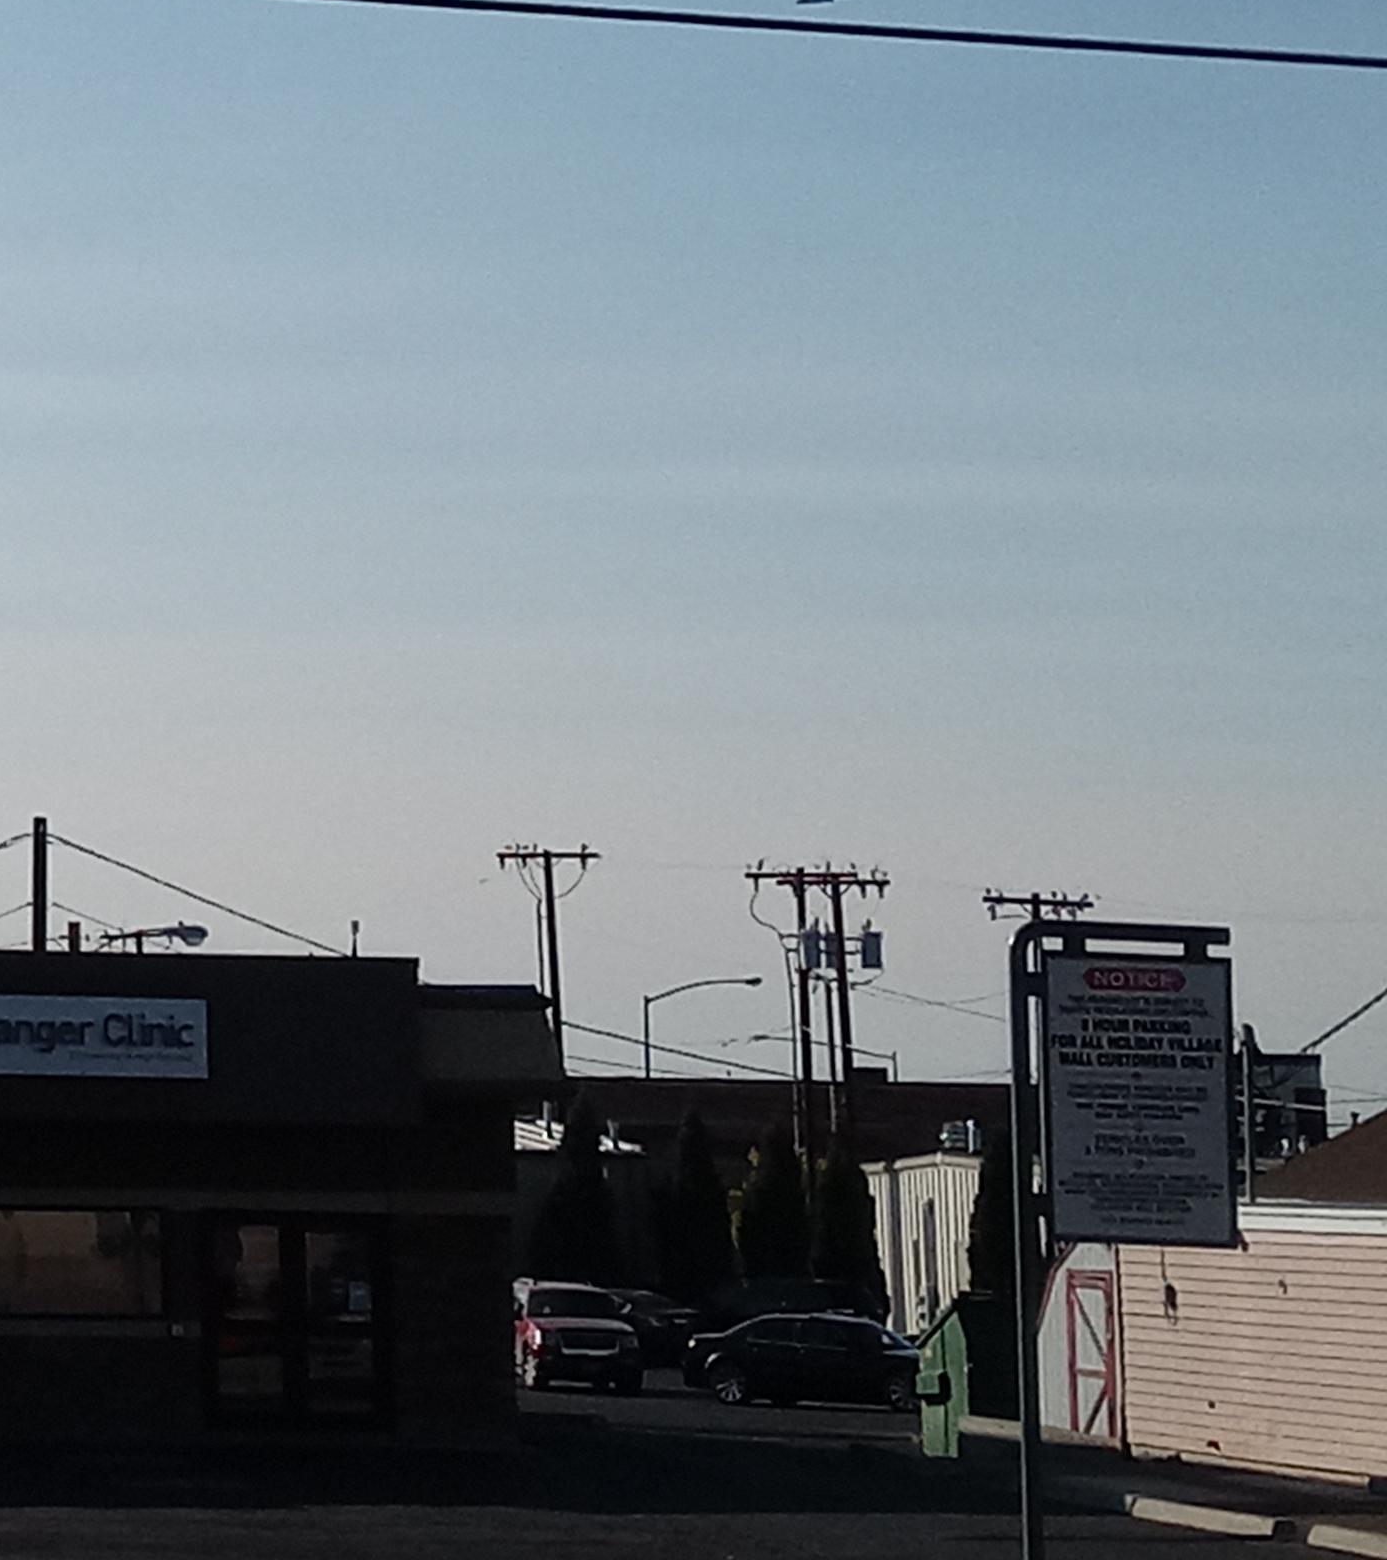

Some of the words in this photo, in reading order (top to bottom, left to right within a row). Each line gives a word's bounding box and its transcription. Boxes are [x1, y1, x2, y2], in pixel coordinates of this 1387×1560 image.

[1094, 971, 1174, 988] NOTICE
[101, 1012, 194, 1046] Clinic
[1133, 1019, 1191, 1034] PARKING
[1051, 1034, 1077, 1048] FOR
[1081, 1035, 1104, 1049] ALL
[1107, 1036, 1164, 1051] HOLIDAY
[1167, 1037, 1223, 1053] VILLAGE
[1181, 1054, 1215, 1070] ONLY
